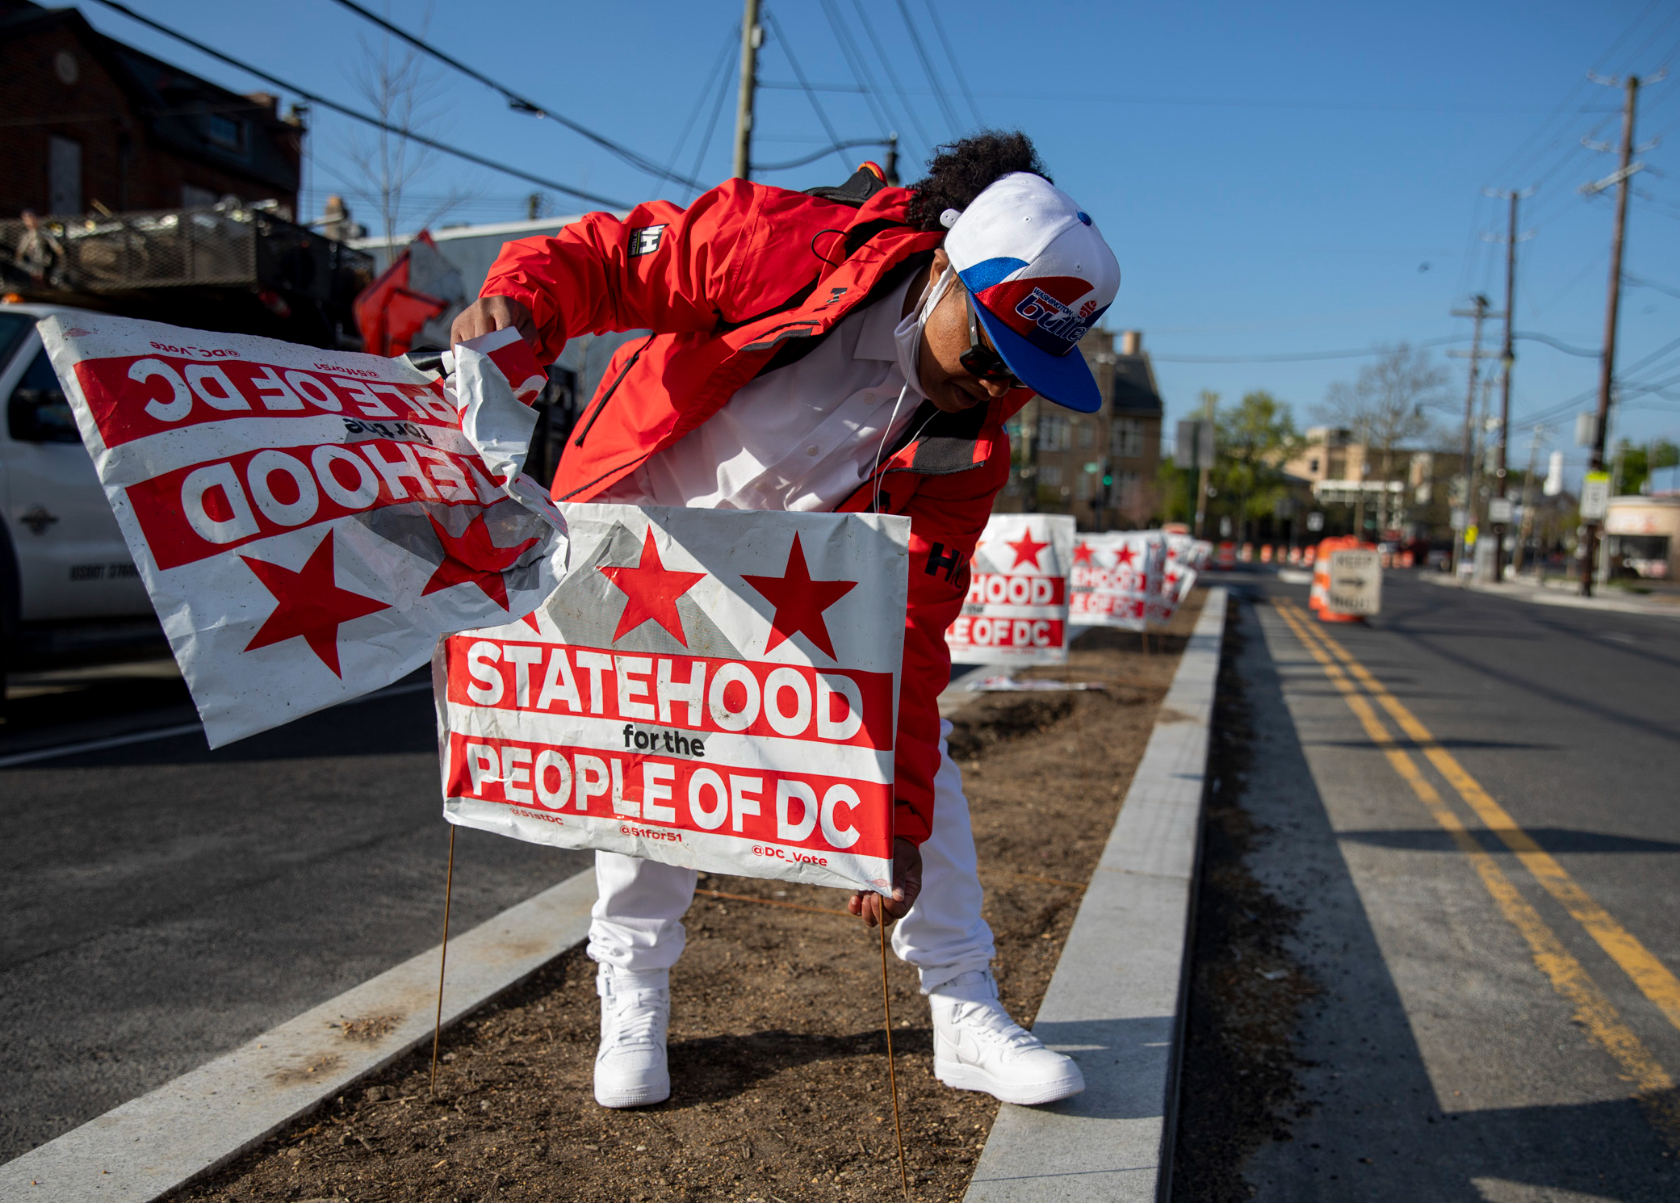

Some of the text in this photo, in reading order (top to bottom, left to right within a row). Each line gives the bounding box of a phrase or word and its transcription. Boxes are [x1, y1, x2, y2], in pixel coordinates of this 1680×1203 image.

[1032, 287, 1074, 316] WASHINGTON
[150, 341, 240, 357] @DC_Vote
[314, 362, 379, 379] @51for51
[127, 358, 252, 422] DC
[250, 366, 343, 412] OF
[342, 417, 434, 445] for the
[972, 617, 1011, 646] OF
[1012, 620, 1050, 647] DC
[466, 641, 863, 740] STATEHOOD
[622, 724, 705, 757] for the
[466, 742, 861, 849] PEOPLE OF DC
[510, 807, 564, 825] @51stDC
[619, 825, 683, 843] @51for51
[751, 844, 828, 867] @DC_Vote
